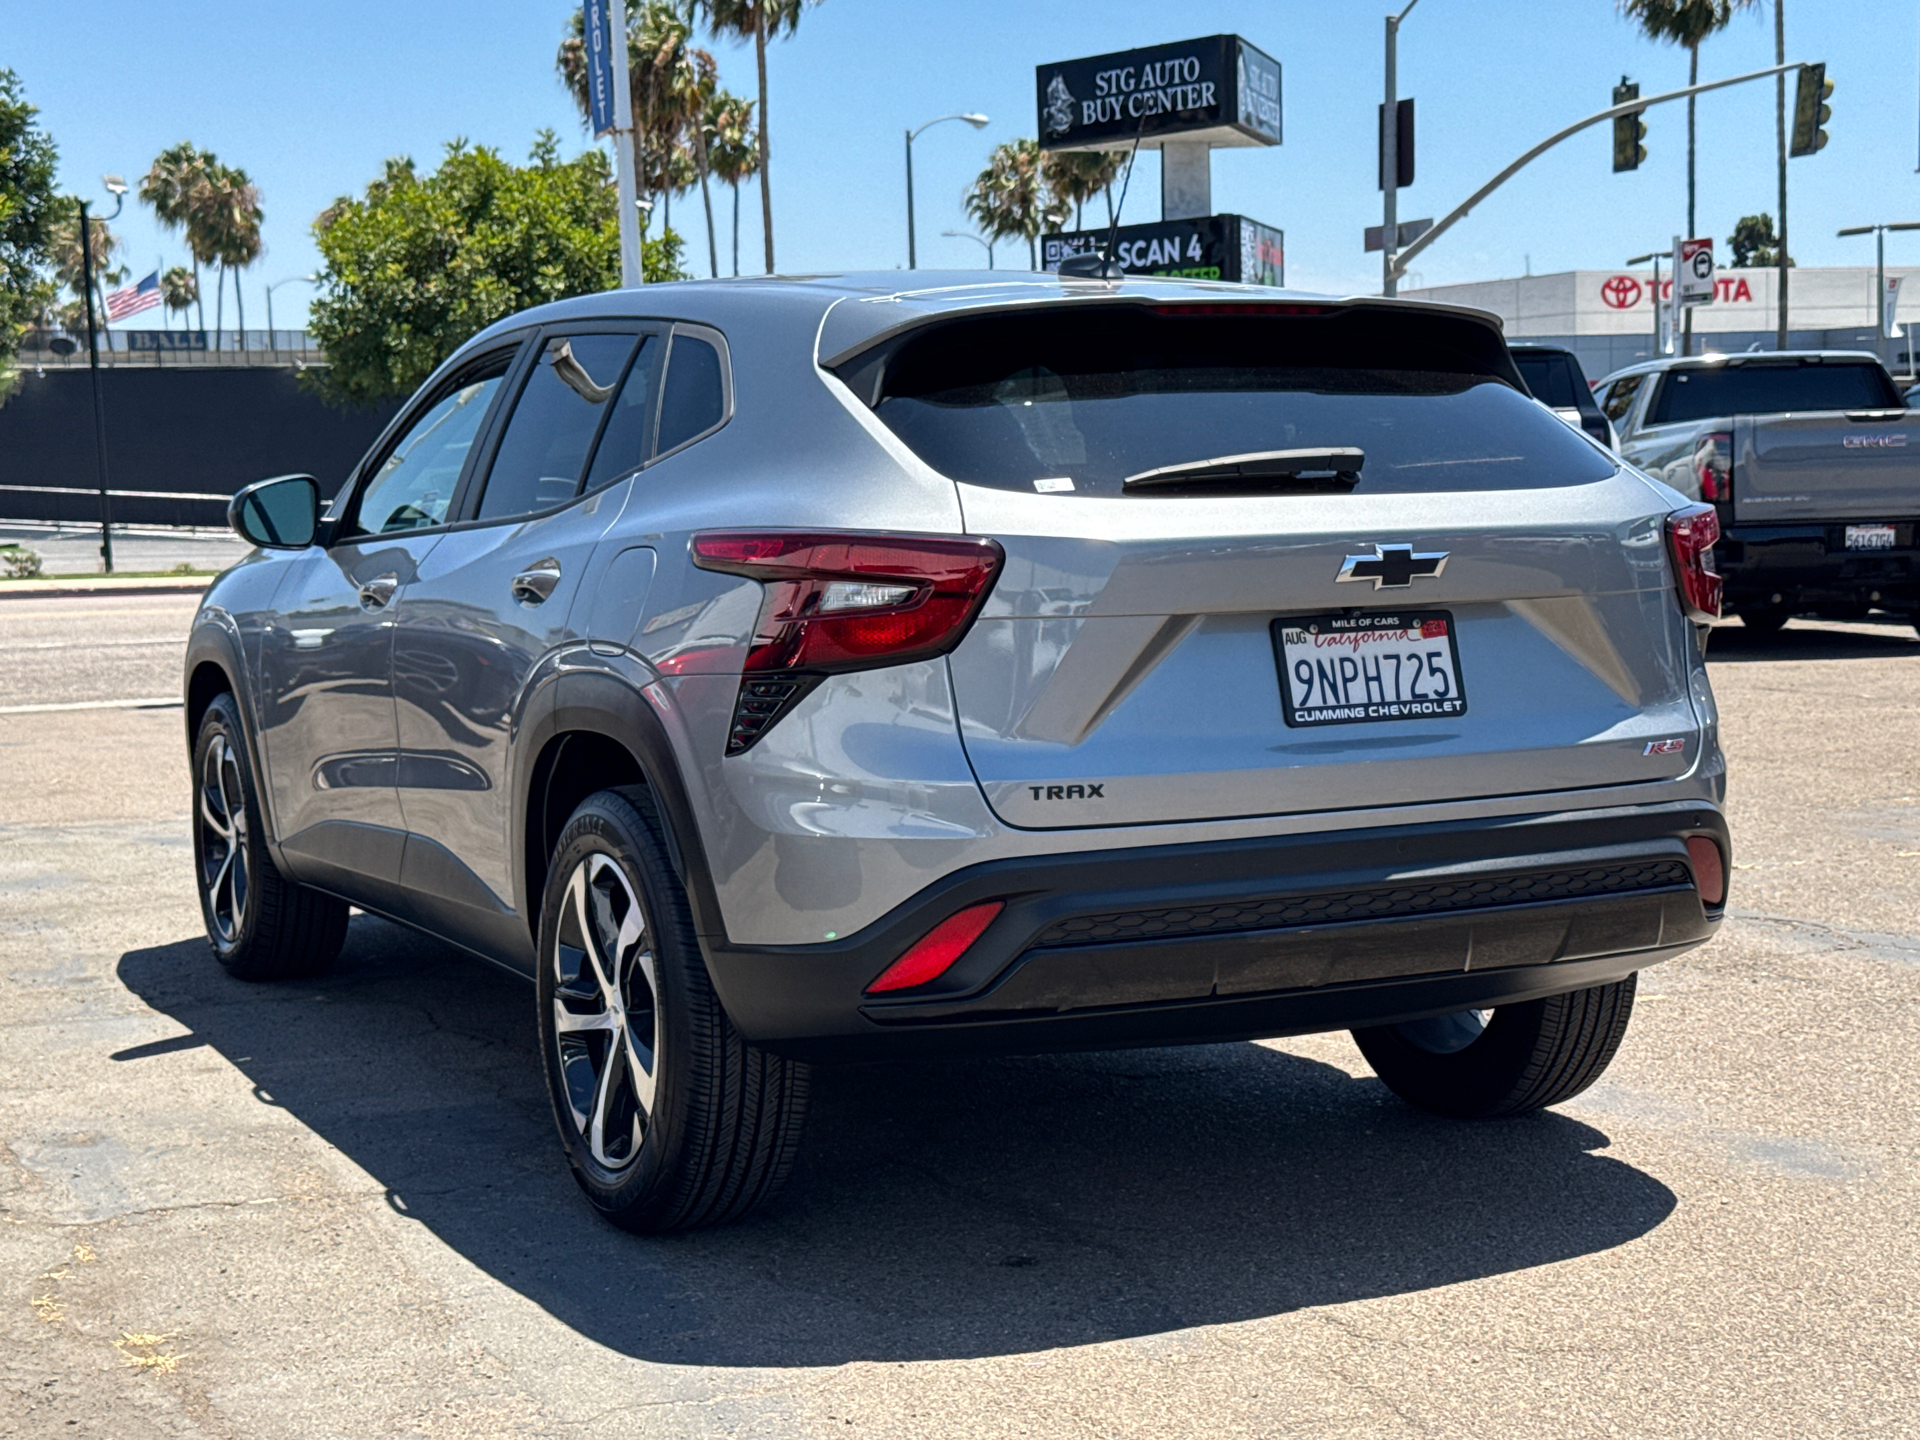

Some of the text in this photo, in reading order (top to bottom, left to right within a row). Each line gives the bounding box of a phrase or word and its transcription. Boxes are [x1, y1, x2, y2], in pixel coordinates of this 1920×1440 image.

[590, 0, 606, 124] ROLET
[1095, 56, 1201, 97] STG AUTO
[1081, 95, 1125, 126] BUY
[1128, 81, 1218, 118] CENTER
[1117, 233, 1203, 269] SCAN 4
[1645, 278, 1753, 305] TTA
[134, 332, 204, 349] BALL
[1843, 434, 1908, 448] GMC
[1331, 617, 1400, 629] MILE OF CARS
[1285, 631, 1307, 646] AUG
[1313, 629, 1421, 653] California
[1294, 651, 1450, 708] 9NPH725
[1295, 700, 1463, 722] CUMMING CHEVROLET
[1643, 738, 1685, 756] RS
[1028, 783, 1105, 801] TRAX
